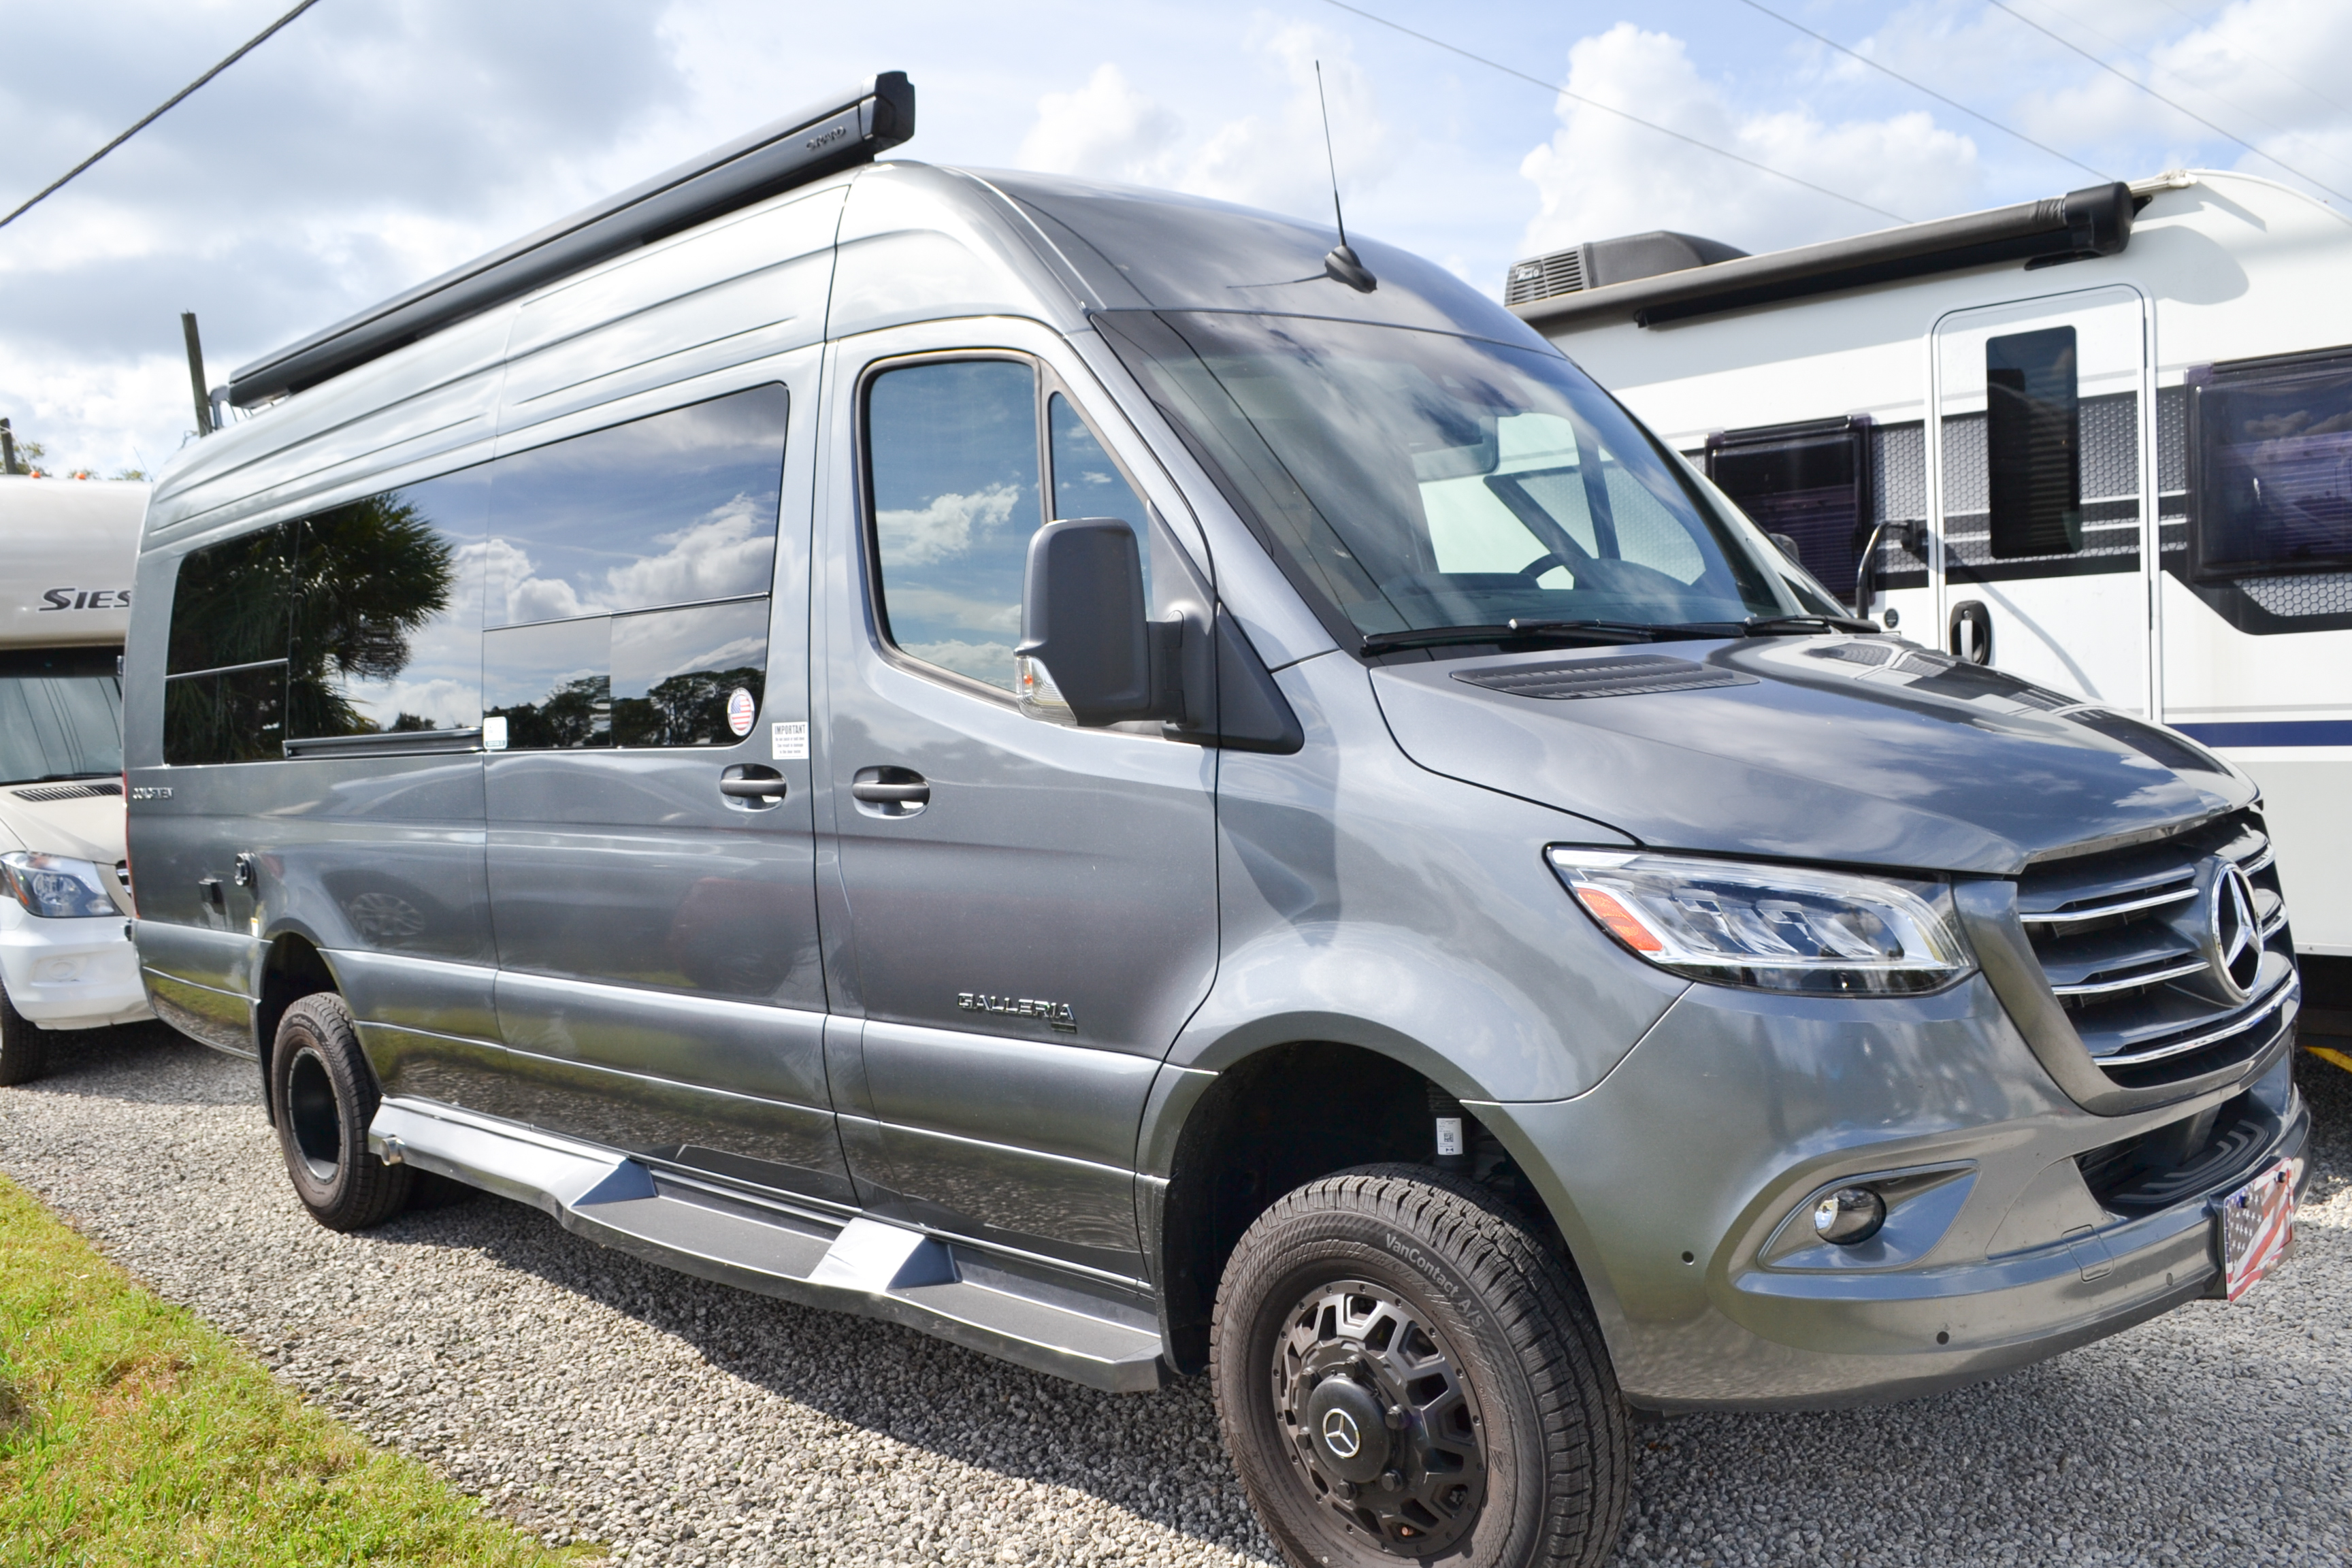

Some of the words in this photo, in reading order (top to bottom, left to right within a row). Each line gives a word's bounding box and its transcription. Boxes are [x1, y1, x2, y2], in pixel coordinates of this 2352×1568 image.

[774, 724, 806, 735] IMPORTANT
[958, 993, 1076, 1020] GALLERIA
[1386, 1233, 1459, 1298] VanContact
[1458, 1298, 1485, 1328] A/S
